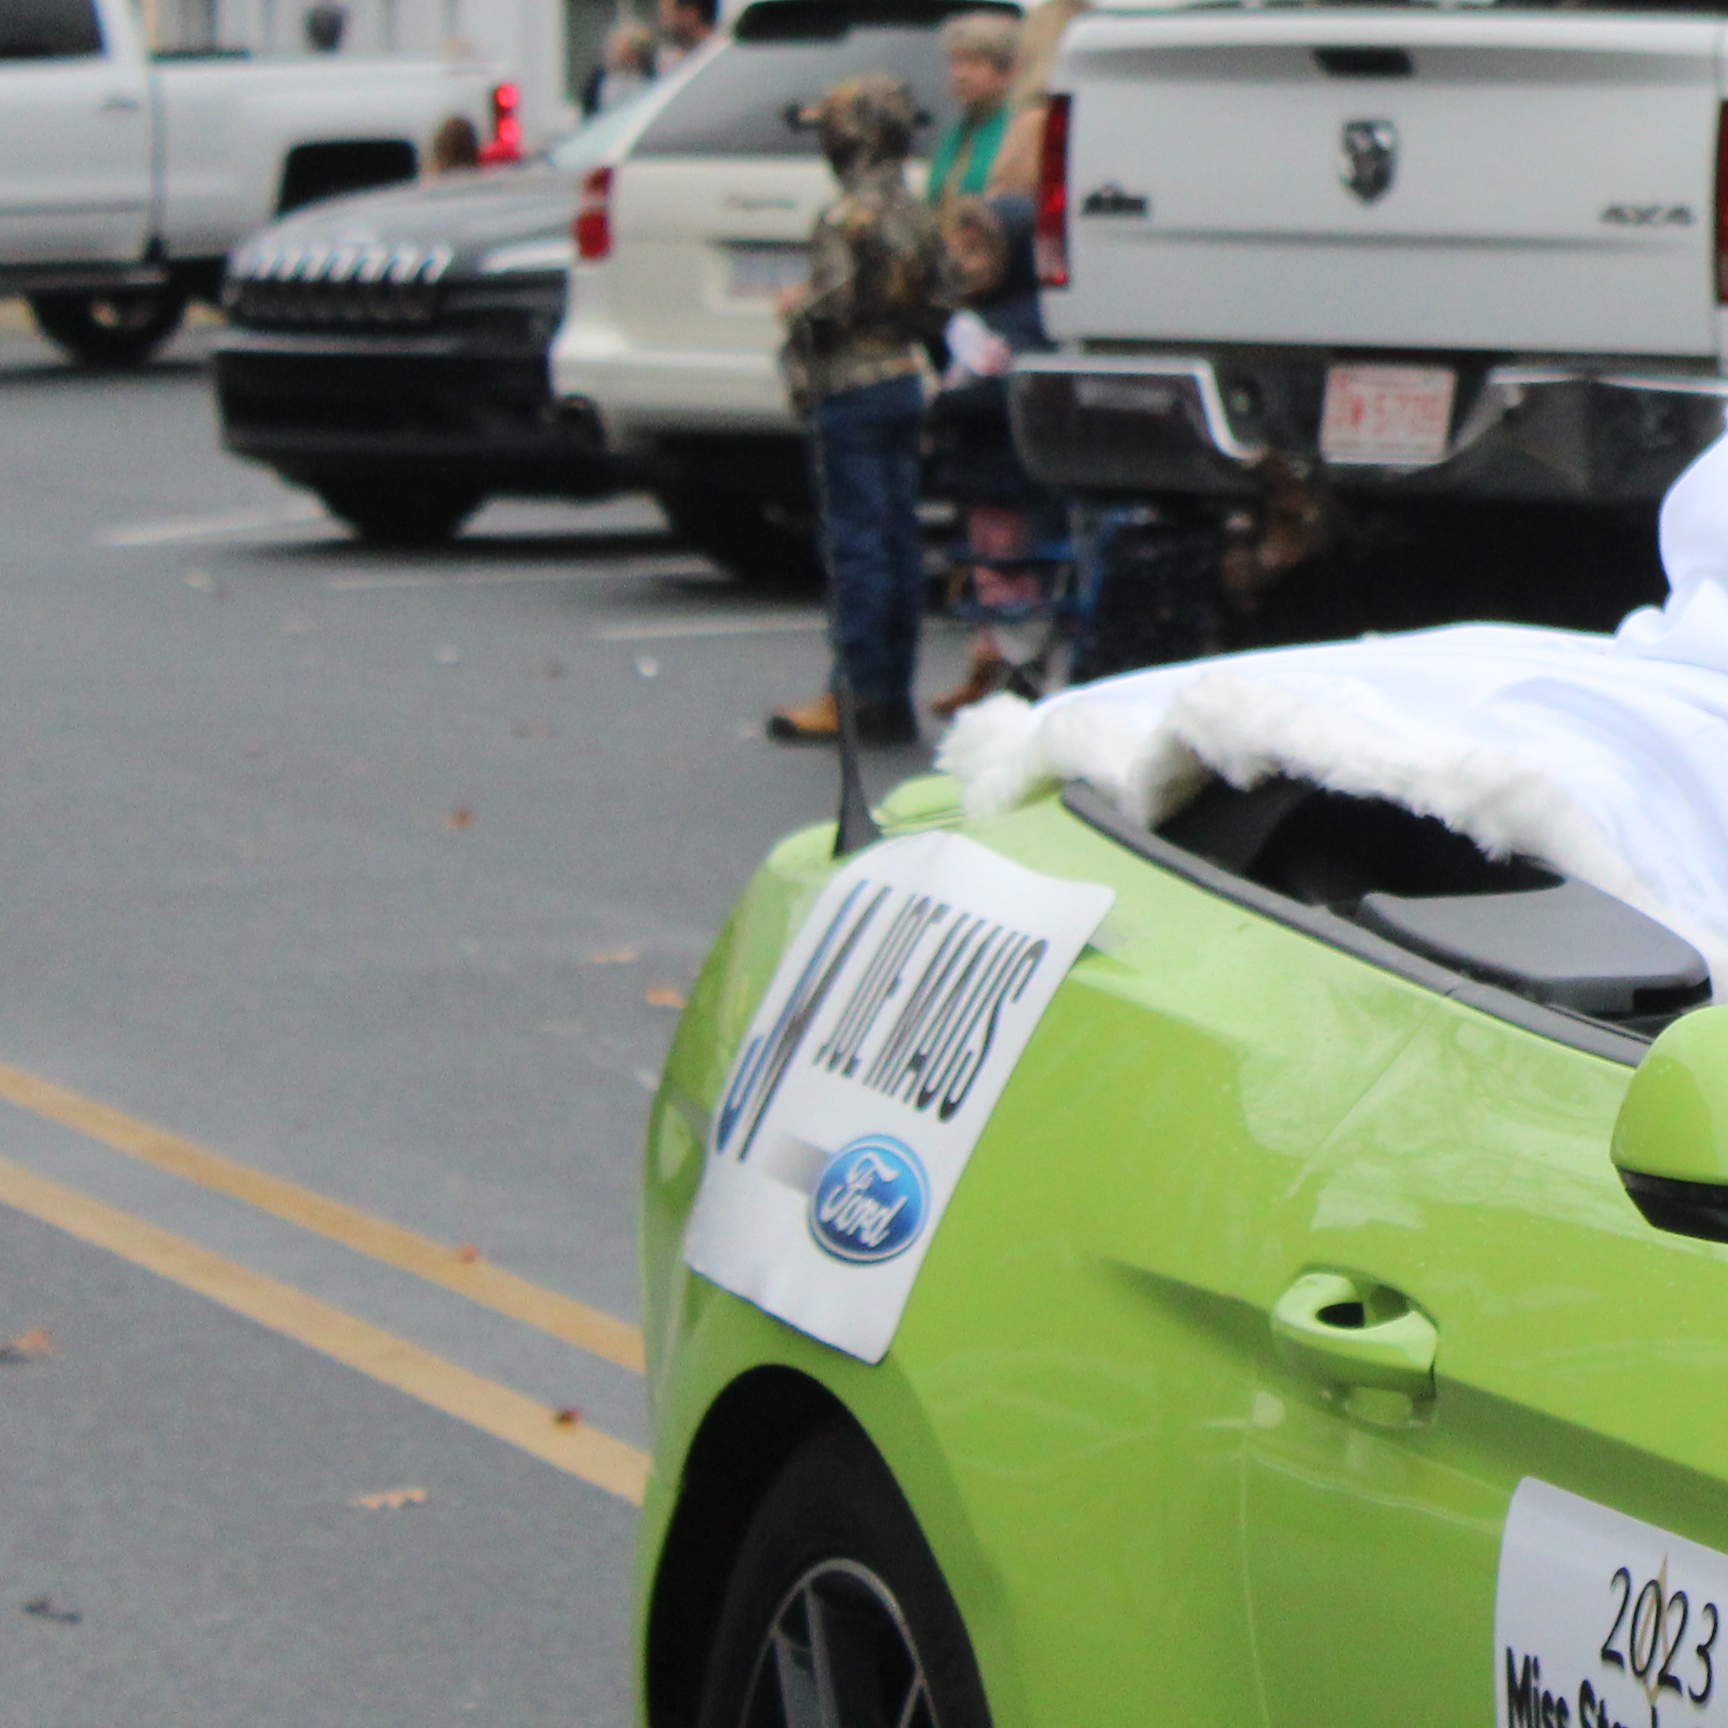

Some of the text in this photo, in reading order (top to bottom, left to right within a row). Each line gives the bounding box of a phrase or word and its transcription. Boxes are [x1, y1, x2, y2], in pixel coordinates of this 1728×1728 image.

[813, 893, 1049, 1125] JOE MAUS
[819, 1151, 908, 1248] Ford
[1600, 1565, 1720, 1706] 2023
